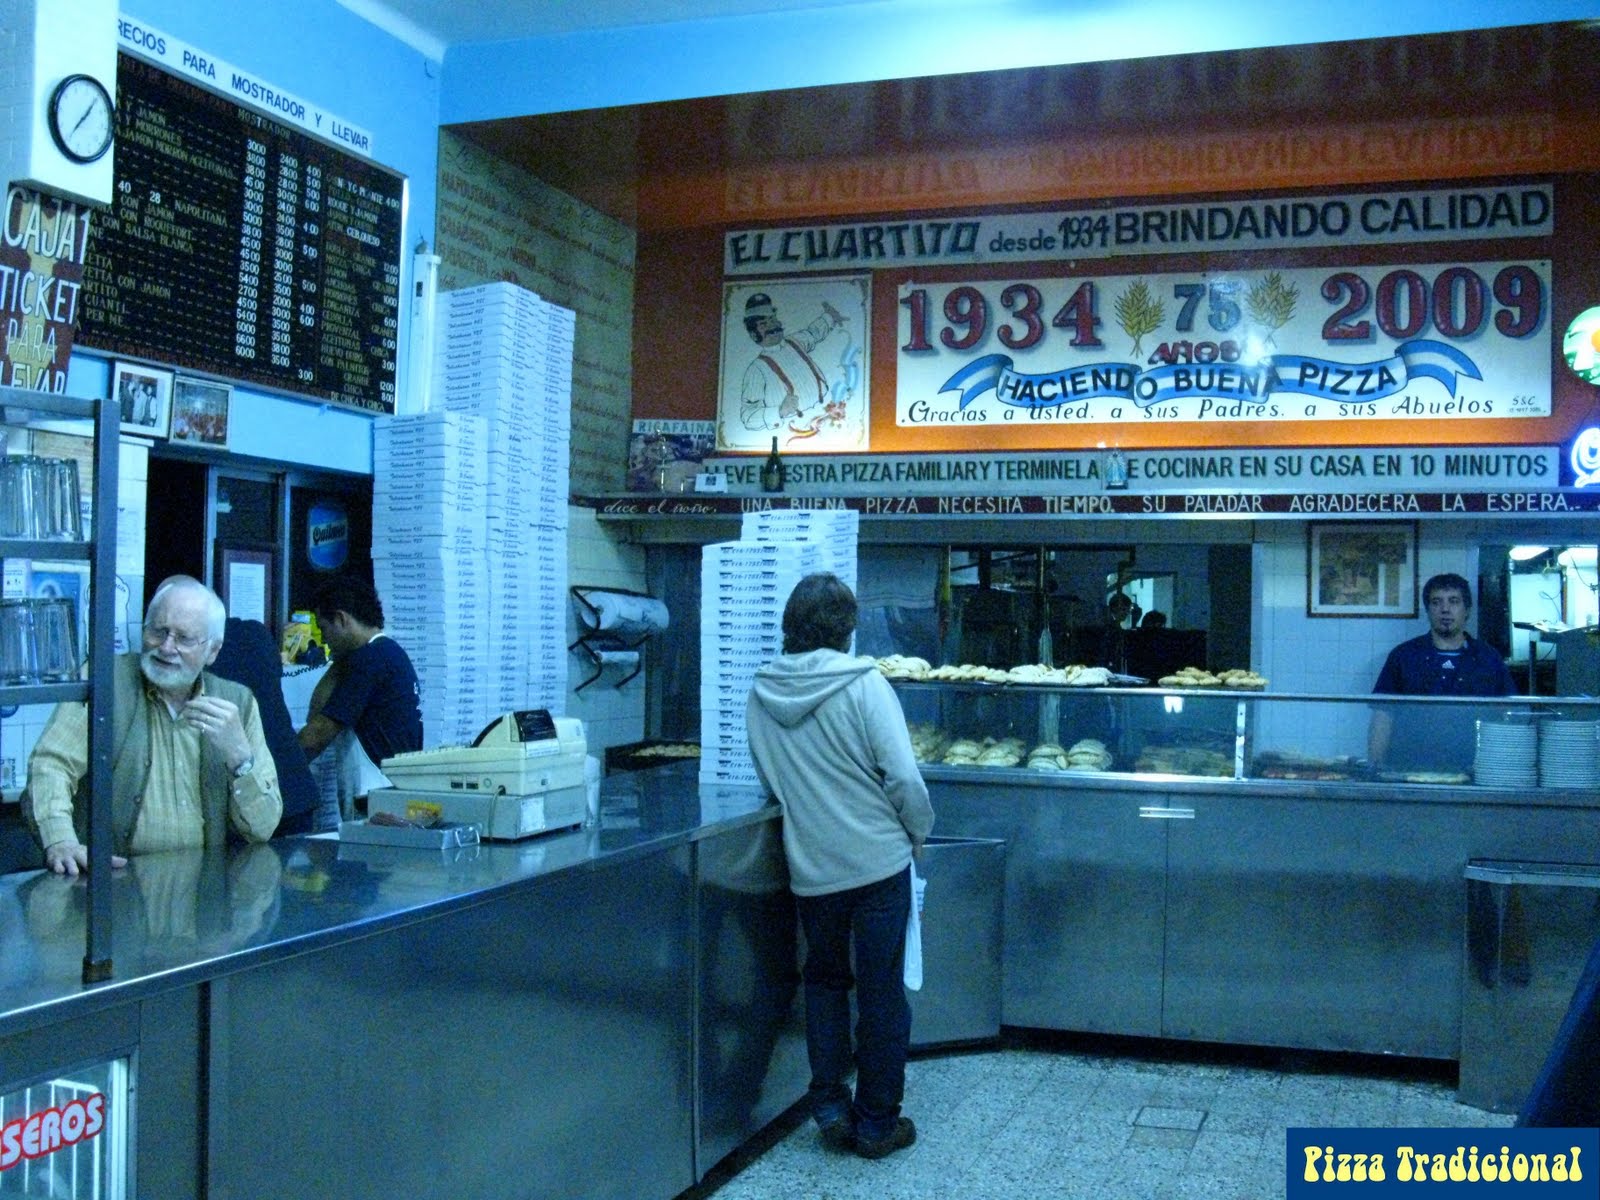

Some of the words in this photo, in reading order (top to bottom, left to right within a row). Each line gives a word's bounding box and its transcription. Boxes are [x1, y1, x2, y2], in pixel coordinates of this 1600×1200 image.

[118, 19, 166, 55] RECIOS
[183, 50, 216, 79] PARA
[232, 73, 305, 121] MOSTRADOR
[315, 112, 323, 128] Y
[332, 120, 369, 151] LLEVAR
[247, 139, 266, 155] 3000
[246, 151, 266, 167] 3800
[245, 163, 265, 179] 3800
[244, 176, 264, 191] 4500
[118, 180, 131, 193] 40
[149, 190, 161, 204] 28
[244, 187, 264, 203] 3000
[243, 200, 263, 215] 3000
[4, 187, 76, 263] CAJA
[243, 212, 262, 227] 5000
[242, 224, 262, 239] 3800
[728, 233, 770, 267] EL
[776, 221, 981, 264] CUARTITO
[989, 227, 1055, 253] desde
[1058, 215, 1112, 248] 1934
[1116, 199, 1351, 245] BRINDANDO
[1360, 189, 1551, 233] CALIDAD
[241, 236, 261, 250] 4500
[240, 248, 260, 263] 4500
[240, 260, 259, 275] 3500
[239, 272, 258, 287] 5400
[0, 264, 81, 324] TICKET
[238, 284, 258, 298] 2700
[237, 297, 257, 311] 4500
[1173, 280, 1243, 332] 75
[1321, 265, 1546, 340] 2009
[236, 308, 256, 322] 5400
[900, 281, 1103, 353] 1934
[236, 321, 255, 335] 6000
[6, 318, 56, 364] PARA
[236, 333, 255, 347] 6600
[235, 345, 255, 359] 6000
[298, 368, 313, 381] 300
[1001, 367, 1159, 402] HACIENDO
[1173, 364, 1283, 398] BUENA
[1298, 365, 1399, 395] PIZZA
[908, 400, 987, 423] Gracias
[1003, 407, 1014, 420] a
[1110, 406, 1122, 419] a
[1304, 404, 1317, 417] a
[1391, 396, 1494, 415] Abuelos
[760, 463, 838, 483] NESTRA
[841, 463, 892, 482] PIZZA
[896, 461, 977, 481] FAMILIAR
[980, 460, 991, 481] Y
[994, 459, 1101, 480] TERMINELA
[1144, 457, 1233, 479] COCINAR
[1239, 456, 1267, 477] EN
[1274, 456, 1302, 477] SU
[1310, 455, 1365, 477] CASA
[1373, 455, 1401, 477] EN
[1410, 455, 1435, 476] 10
[1445, 454, 1548, 477] MINUTOS
[741, 498, 773, 513] UNA
[790, 497, 847, 510] BUENA
[866, 497, 919, 514] PIZZA
[938, 497, 1024, 514] NECESITA
[1142, 495, 1167, 513] SU
[1185, 495, 1263, 513] PALADAR
[1290, 494, 1420, 513] AGRADECERA
[1442, 493, 1467, 512] LA
[0, 1093, 105, 1171] SEROS
